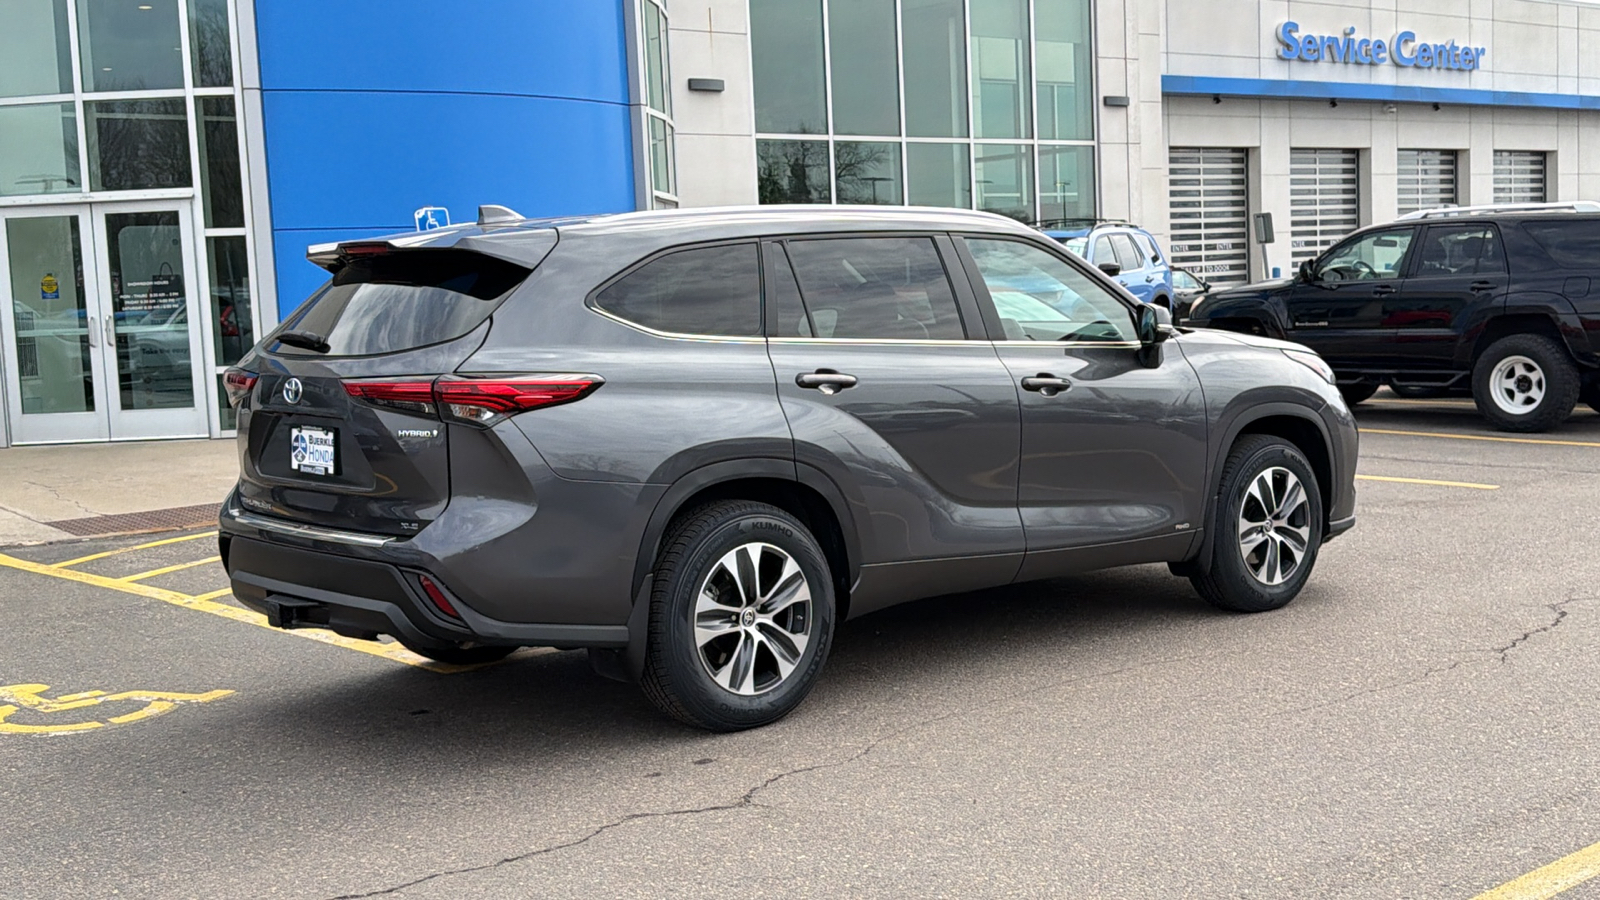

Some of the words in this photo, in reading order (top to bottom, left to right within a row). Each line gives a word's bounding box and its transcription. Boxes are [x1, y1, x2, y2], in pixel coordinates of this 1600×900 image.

[1276, 21, 1387, 64] Service
[1391, 31, 1486, 70] Center
[309, 445, 334, 463] HONDA
[752, 521, 793, 538] KUMHO
